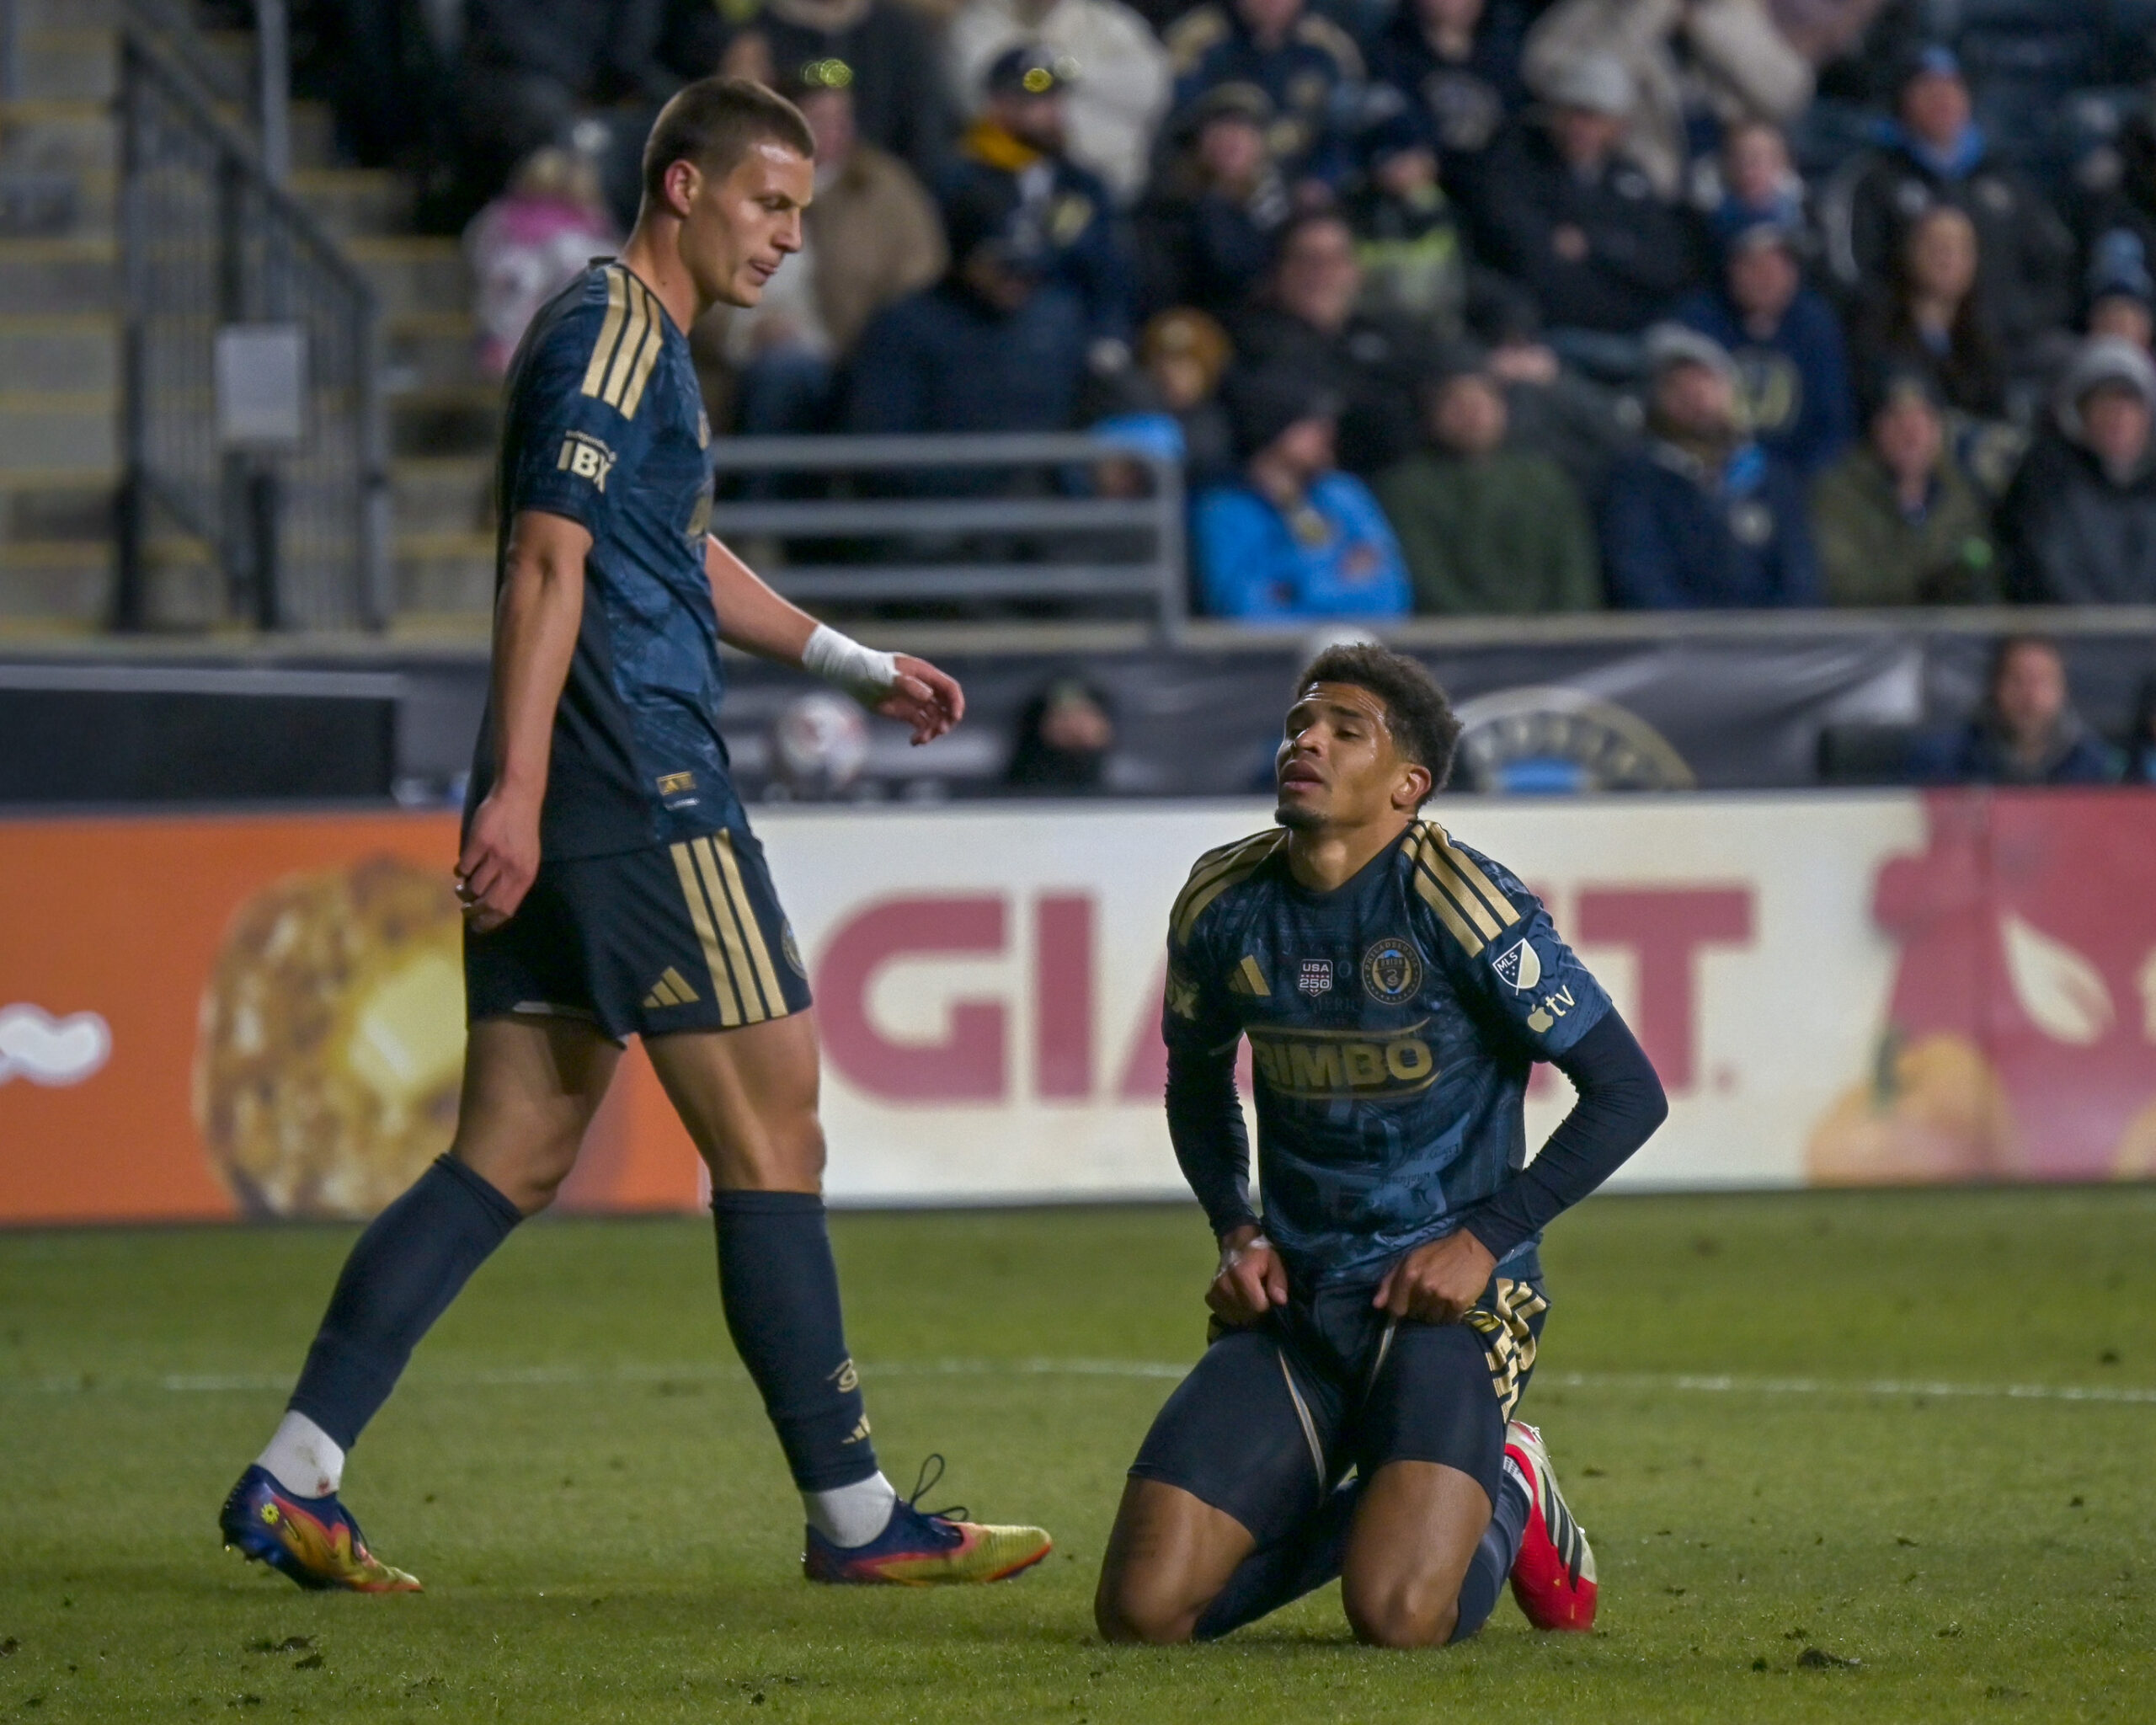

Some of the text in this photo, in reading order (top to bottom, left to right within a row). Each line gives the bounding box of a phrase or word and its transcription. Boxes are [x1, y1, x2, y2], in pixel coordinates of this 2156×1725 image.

[557, 439, 612, 494] IBX
[1302, 964, 1329, 972] USA
[1497, 952, 1518, 971] MLS
[813, 887, 1753, 1100] GIT
[1299, 979, 1330, 989] 250
[1545, 984, 1575, 1017] tv
